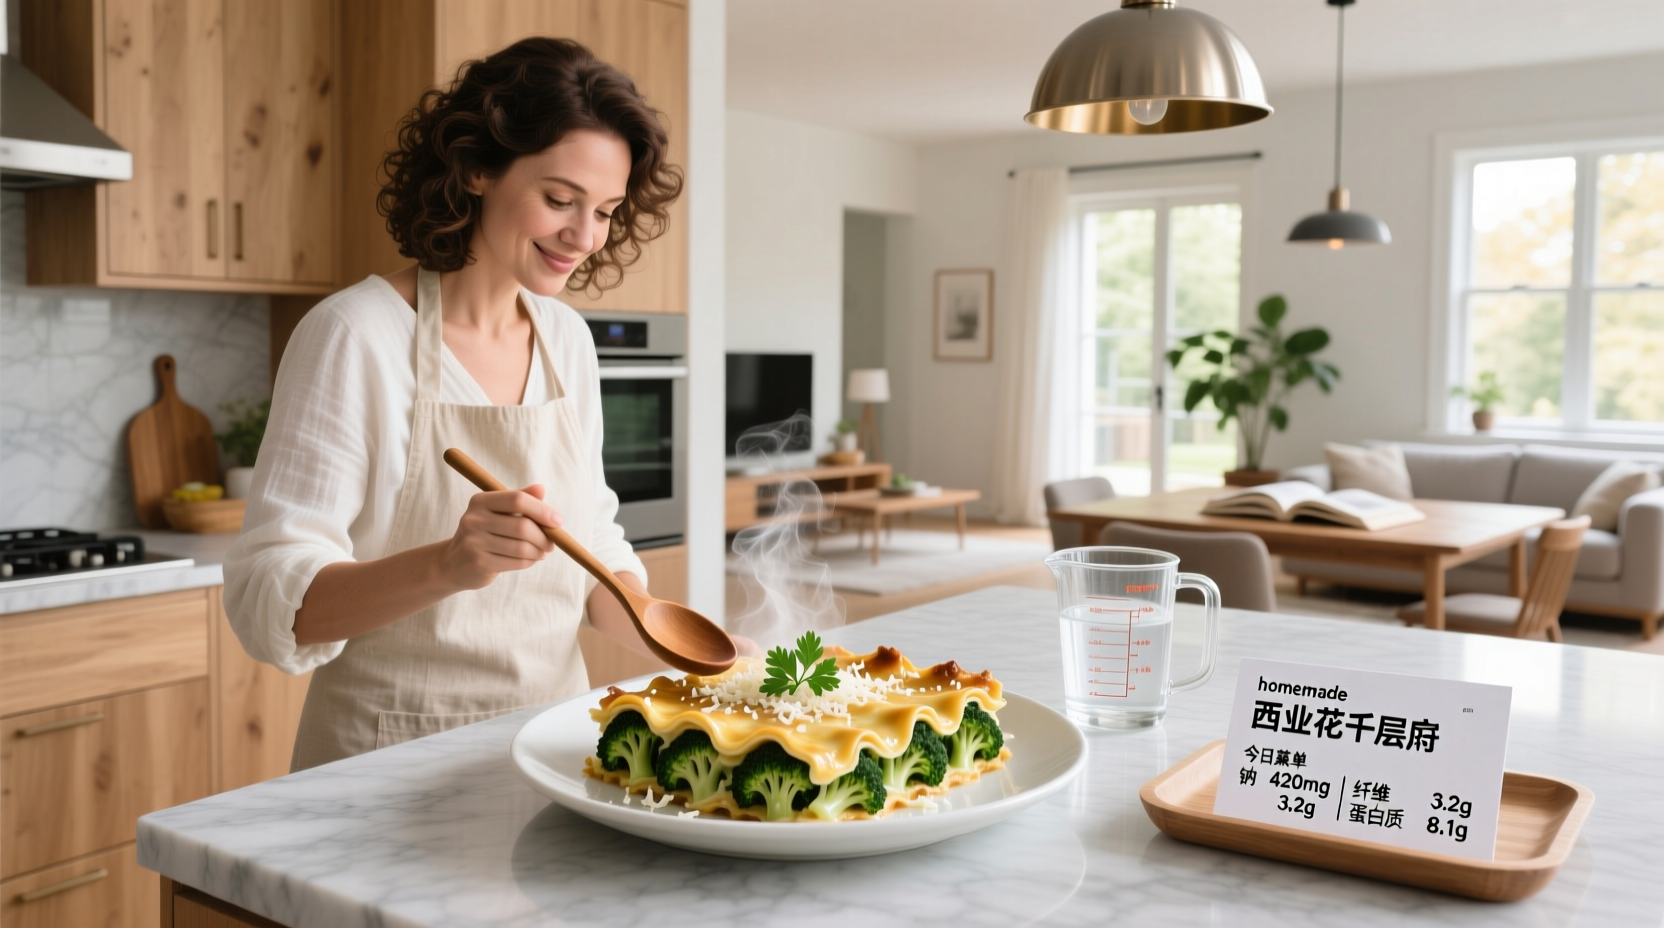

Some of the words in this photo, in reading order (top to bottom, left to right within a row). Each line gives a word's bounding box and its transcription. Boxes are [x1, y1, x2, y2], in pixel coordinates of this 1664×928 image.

[1257, 675, 1348, 702] homemade
[1239, 766, 1258, 787] 钠
[1269, 771, 1331, 800] 420mg
[1277, 794, 1316, 820] 3.2g
[1430, 792, 1473, 819] 3.2g
[1348, 802, 1405, 830] 蛋白质
[1426, 816, 1469, 843] 8.1g
